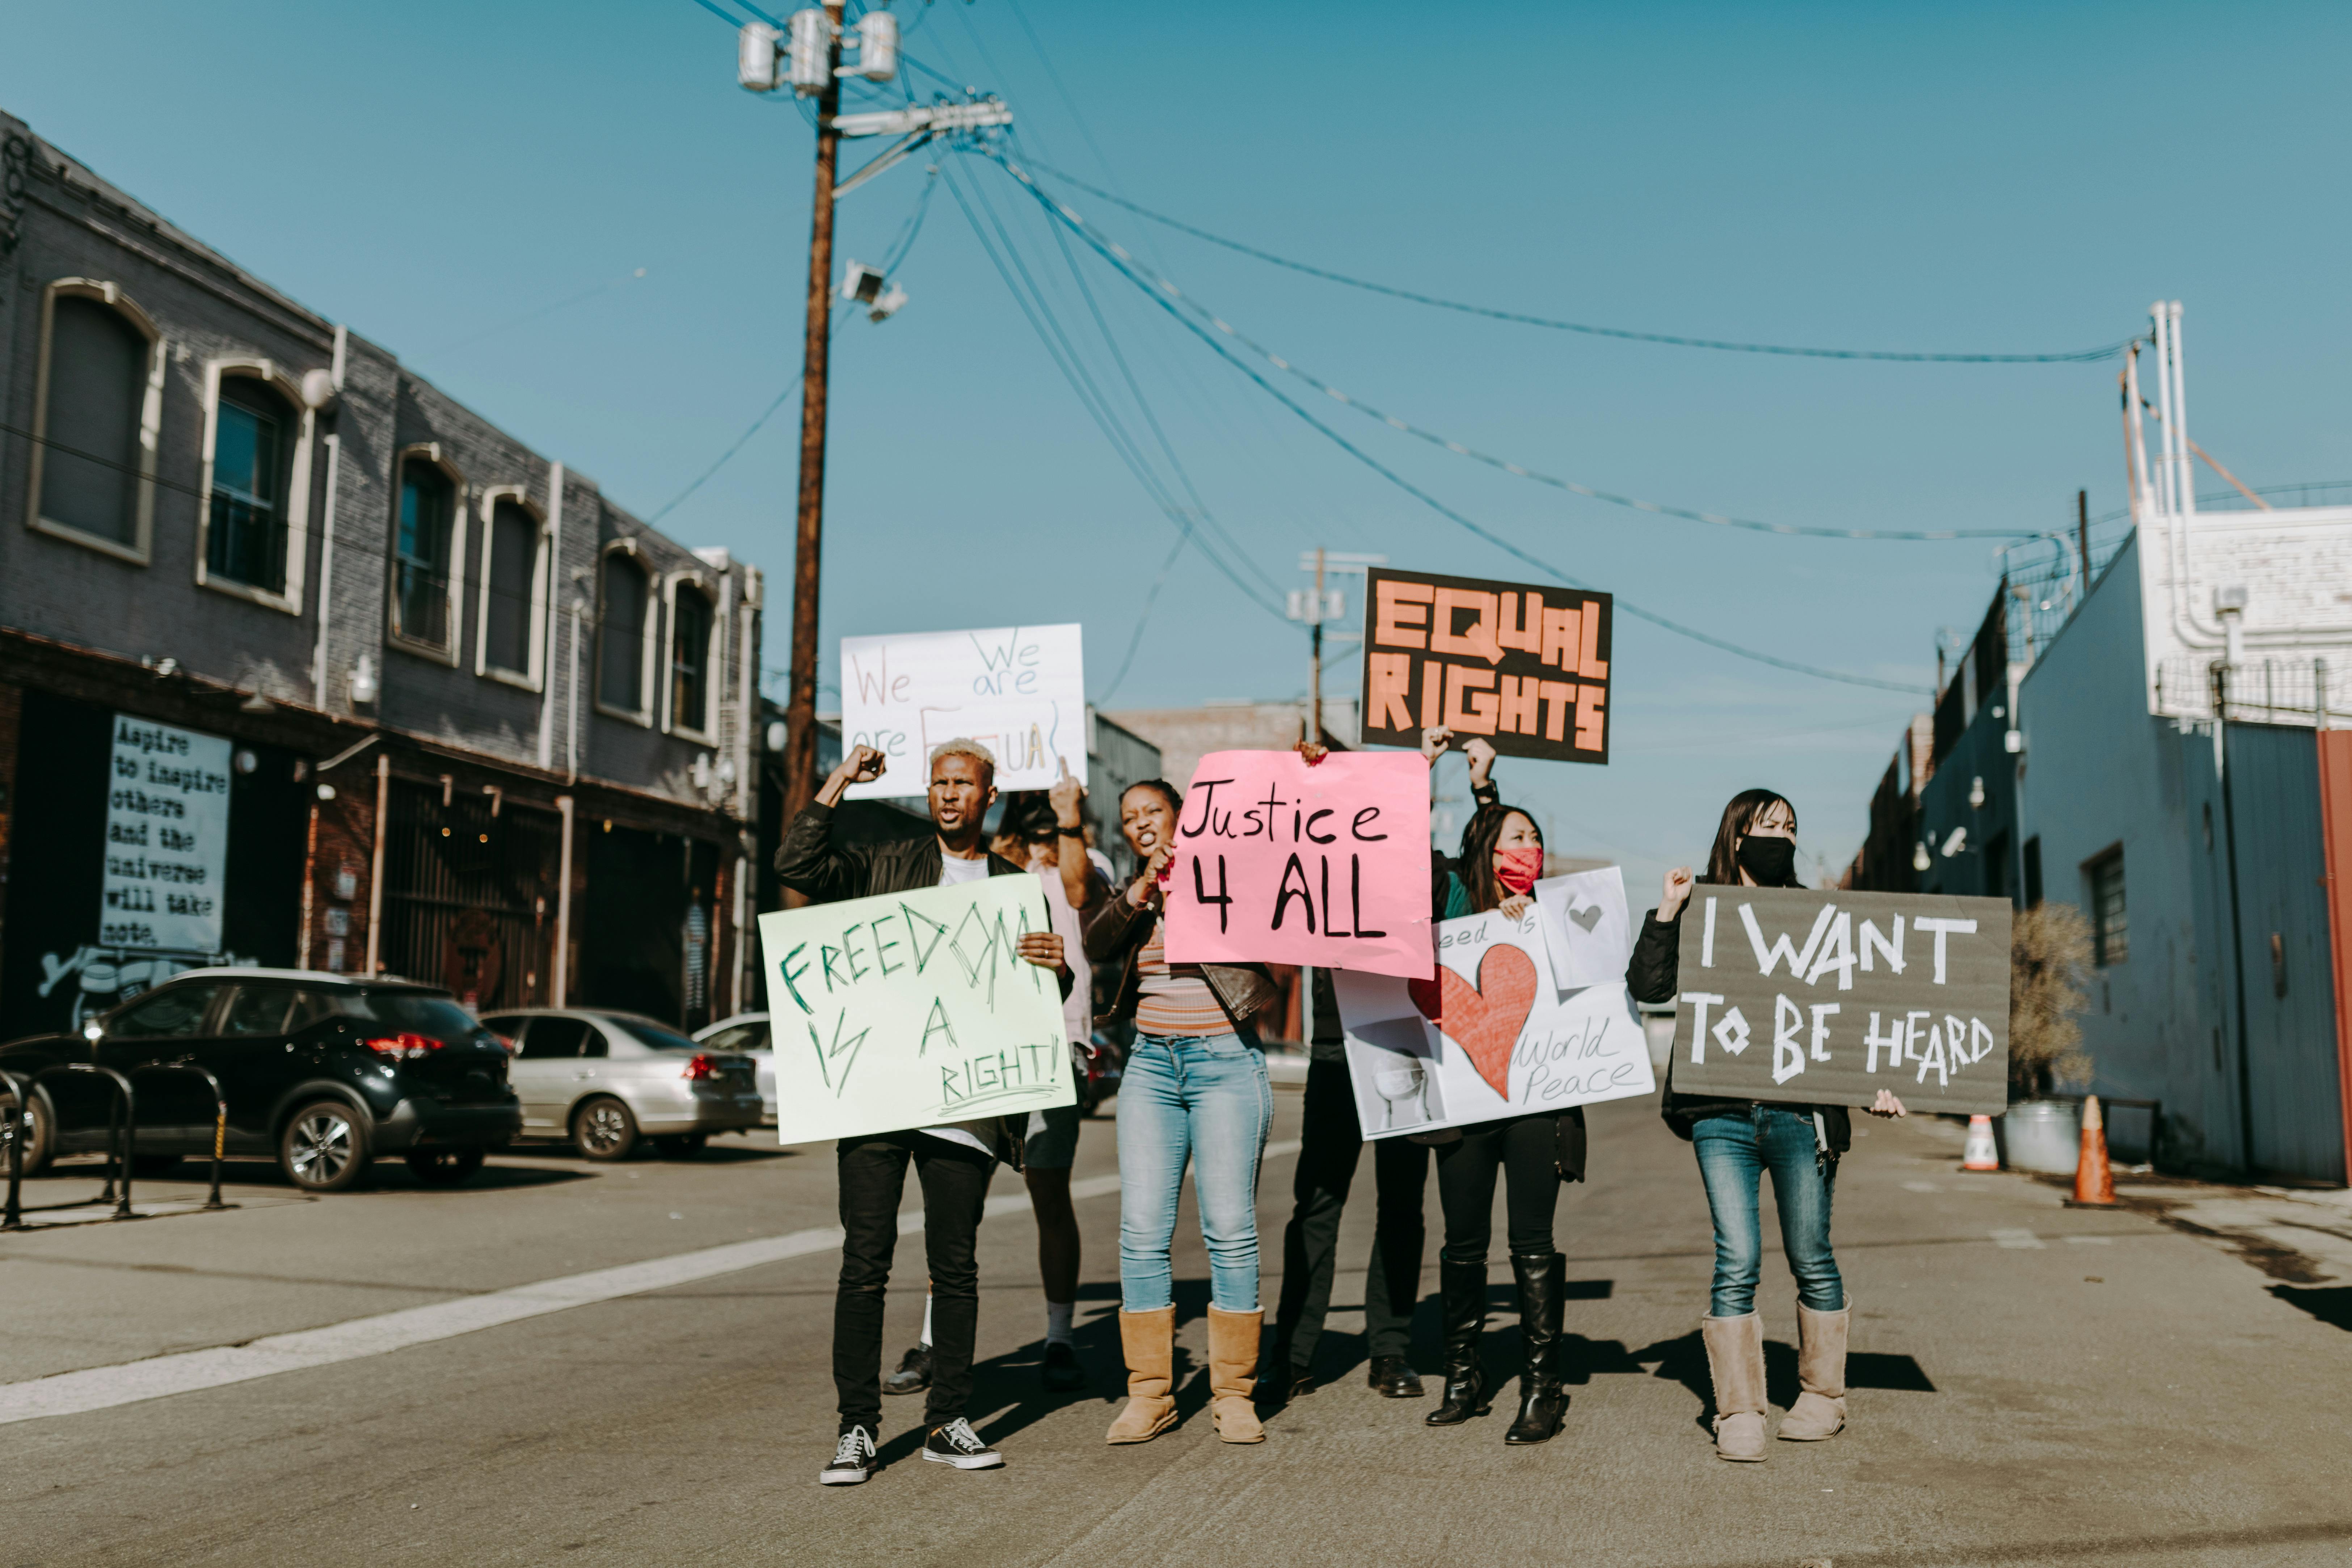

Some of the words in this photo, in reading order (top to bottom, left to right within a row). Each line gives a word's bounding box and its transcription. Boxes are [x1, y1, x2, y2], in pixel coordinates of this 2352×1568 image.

[969, 626, 1040, 672] We
[1375, 579, 1608, 680] EQUAL
[852, 644, 911, 706] We
[973, 669, 1039, 696] are
[1368, 652, 1606, 752] RIGHTS
[117, 721, 190, 756] Aspire
[116, 755, 138, 779] to
[148, 759, 226, 794] inspire
[110, 789, 185, 819] others
[1181, 779, 1388, 844] Justice
[110, 821, 148, 846] and
[160, 827, 194, 852] the
[108, 855, 206, 885] universe
[1193, 855, 1233, 934] 4
[1271, 852, 1387, 938] ALL
[107, 886, 156, 913] will
[167, 893, 212, 917] take
[779, 901, 1041, 1015] FREEDOM
[1433, 920, 1489, 953] eed
[1701, 896, 1717, 968] I
[1738, 902, 1978, 991] WANT
[807, 1006, 873, 1099] IS
[918, 995, 958, 1058] A
[1512, 1016, 1621, 1068] World
[1772, 993, 1841, 1085] BE
[1863, 1011, 1994, 1089] HEARD
[941, 1033, 1059, 1105] RIGHT!
[1523, 1062, 1645, 1106] Peace
